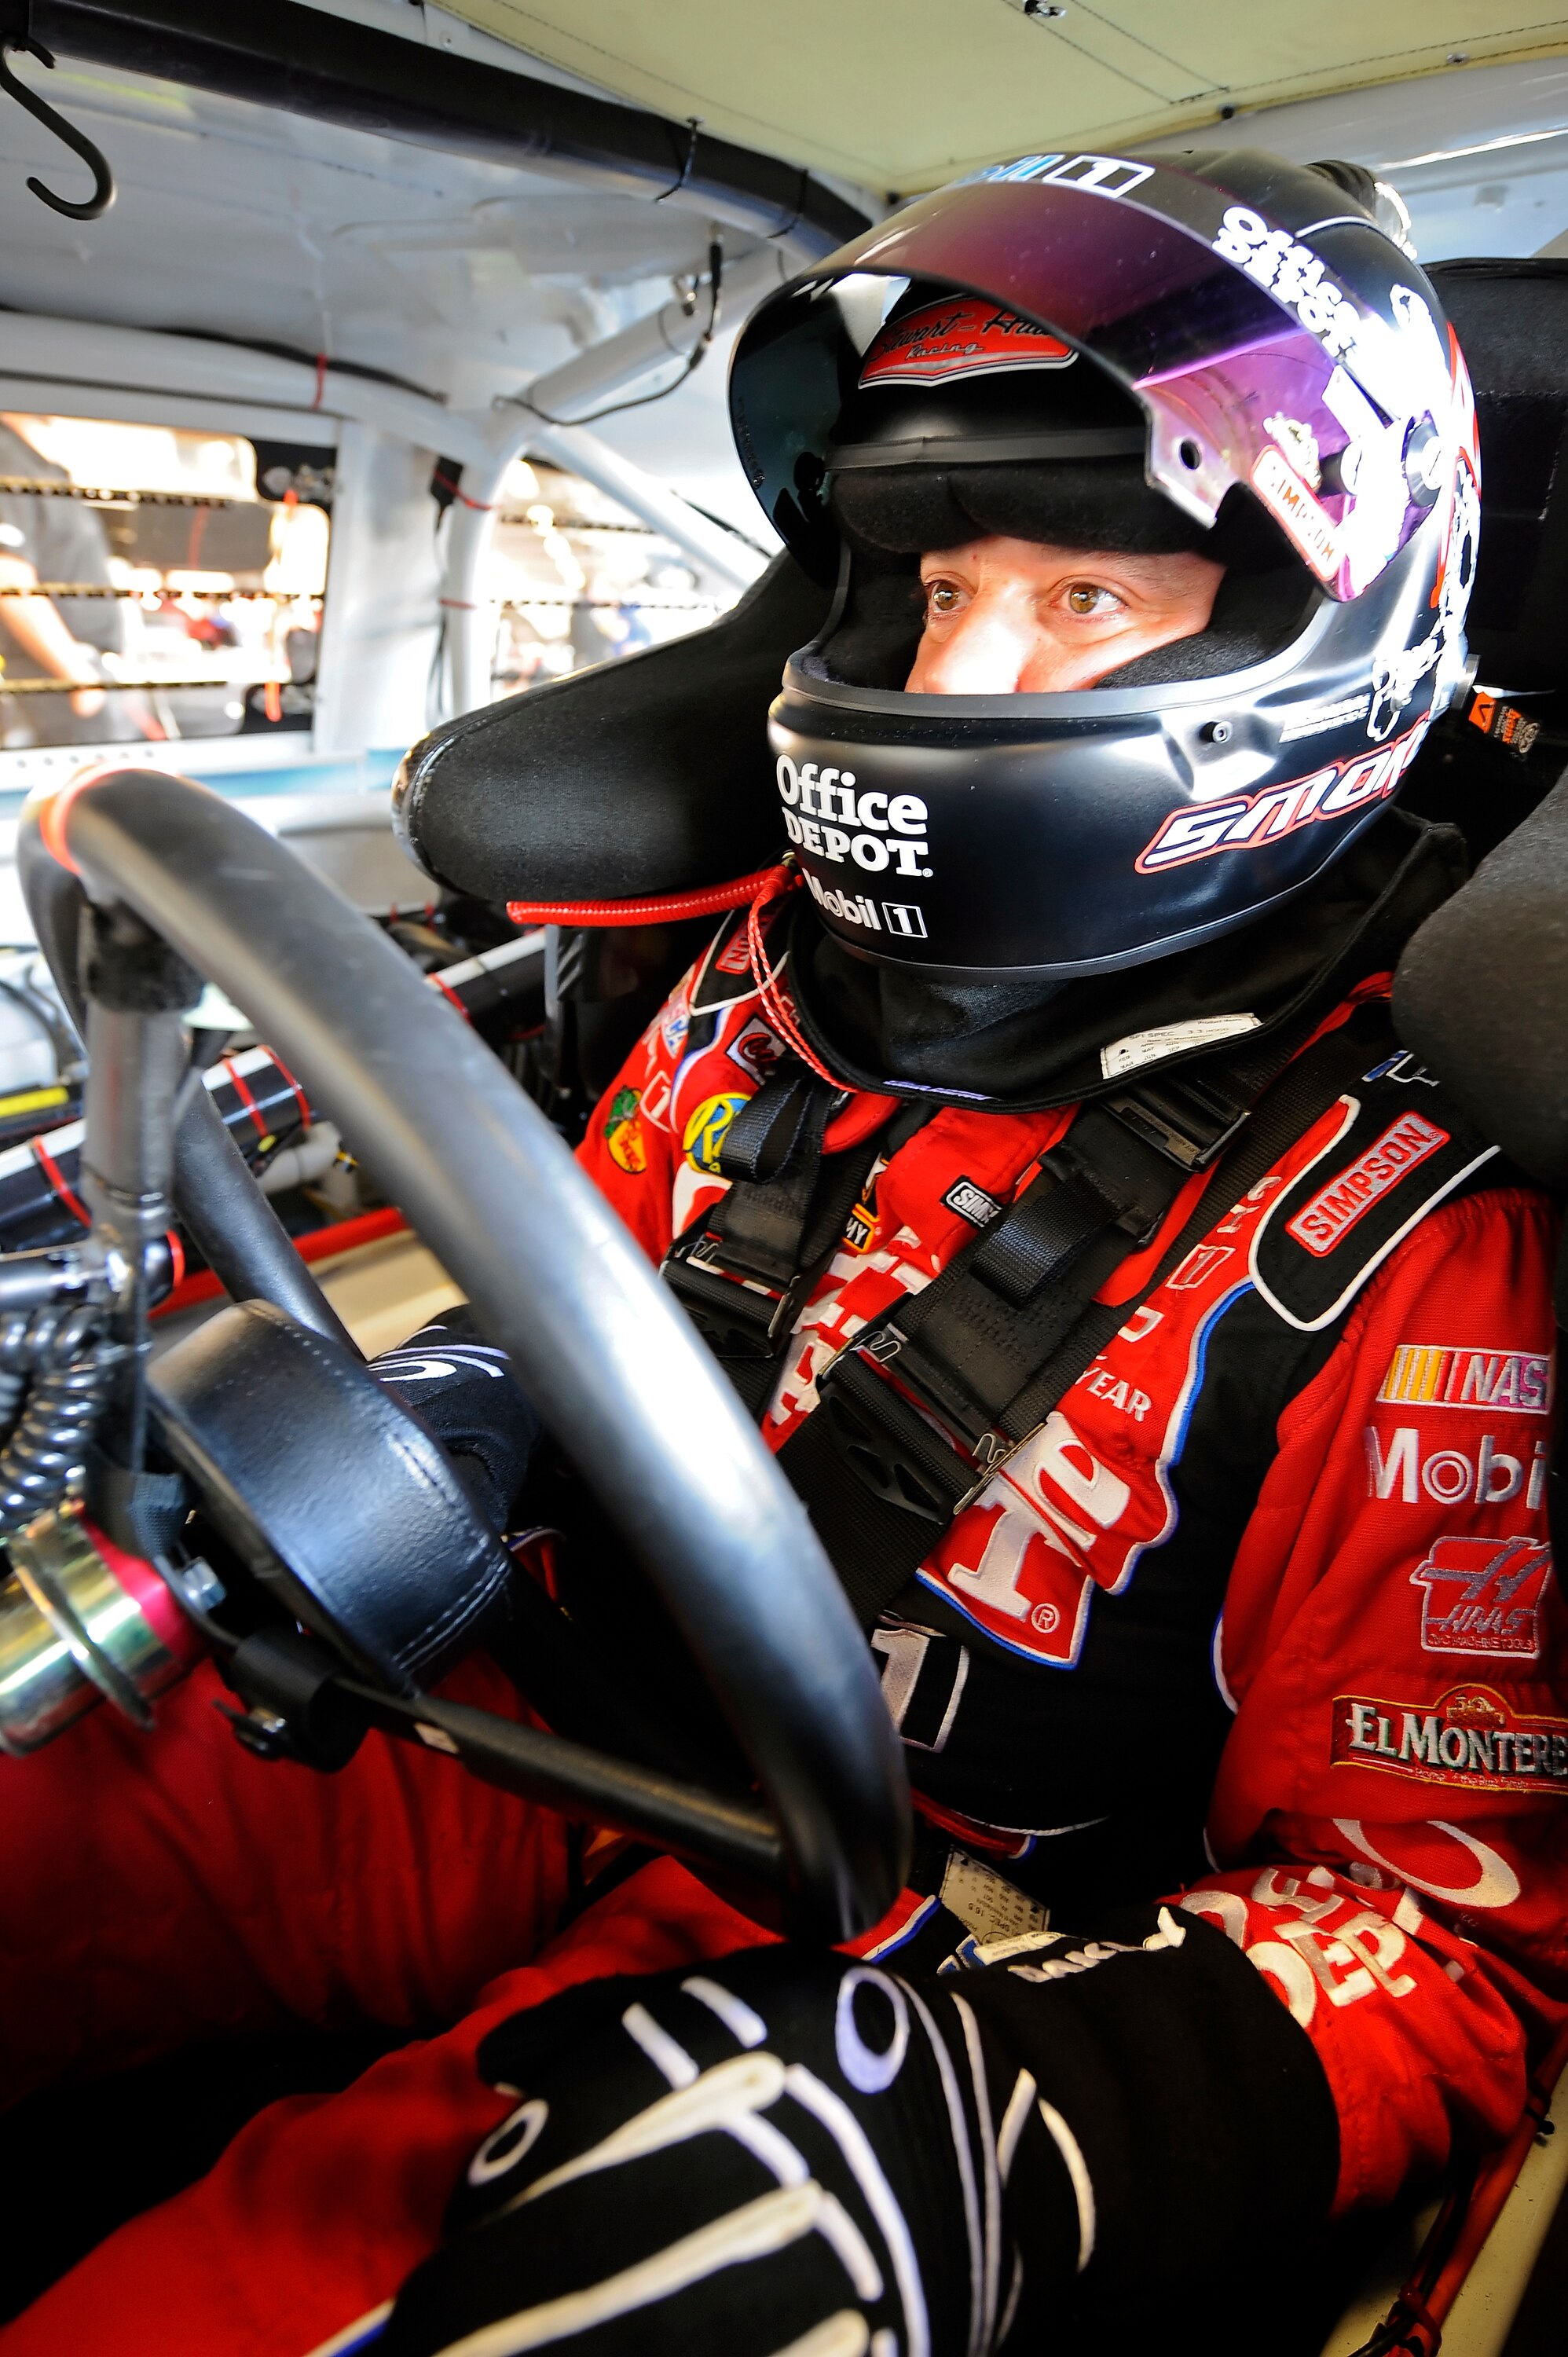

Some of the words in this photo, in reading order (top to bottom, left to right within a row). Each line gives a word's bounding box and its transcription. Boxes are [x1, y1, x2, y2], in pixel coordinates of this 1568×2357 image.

[905, 343, 984, 360] Racing
[776, 754, 929, 835] Office
[1142, 718, 1432, 867] SMOK
[801, 867, 882, 930] Mobil
[1301, 1121, 1434, 1243] SIMPSON
[1460, 1354, 1548, 1406] NAS
[1364, 1425, 1546, 1509] Mobi
[1398, 1713, 1568, 1776] MONTERE
